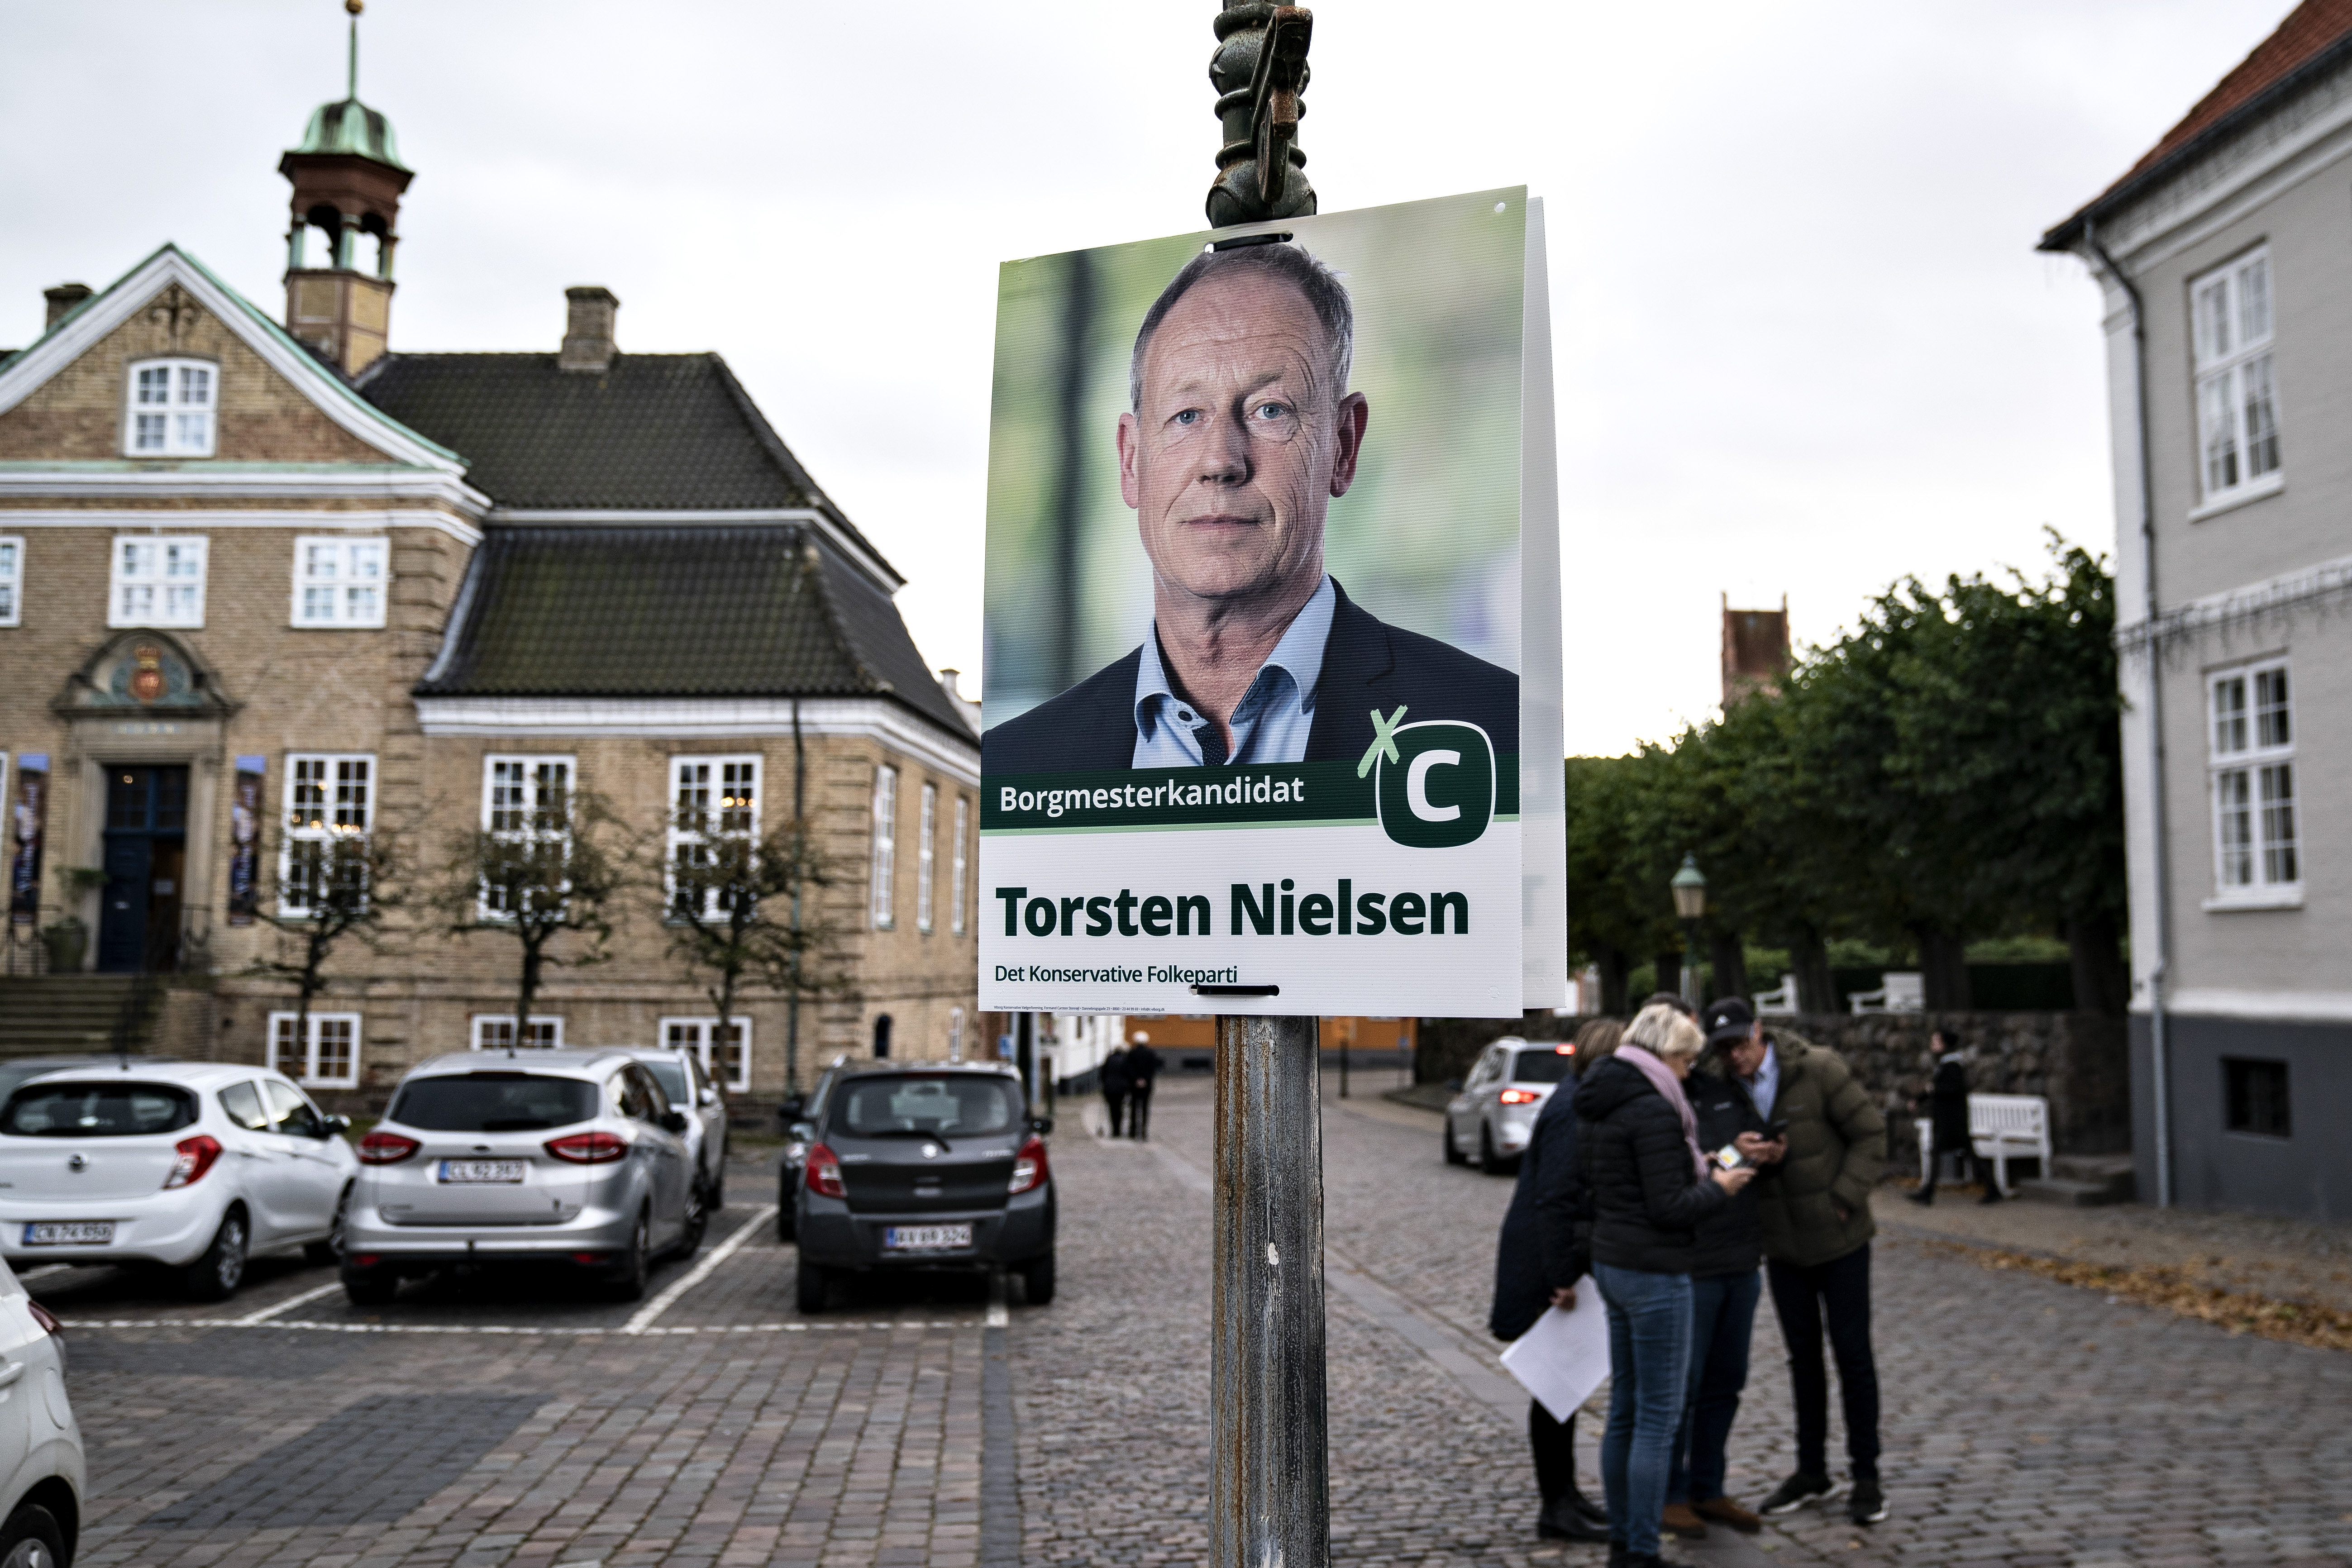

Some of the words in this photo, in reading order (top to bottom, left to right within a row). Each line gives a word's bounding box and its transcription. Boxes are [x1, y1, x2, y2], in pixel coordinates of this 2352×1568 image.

[1000, 775, 1304, 817] Borgmesterkandidat
[1406, 749, 1461, 822] C
[996, 887, 1211, 937] Torsten
[1231, 878, 1469, 936] Nielsen
[995, 965, 1025, 982] Det
[1030, 965, 1142, 982] Konservative
[1148, 965, 1237, 985] Folkeparti
